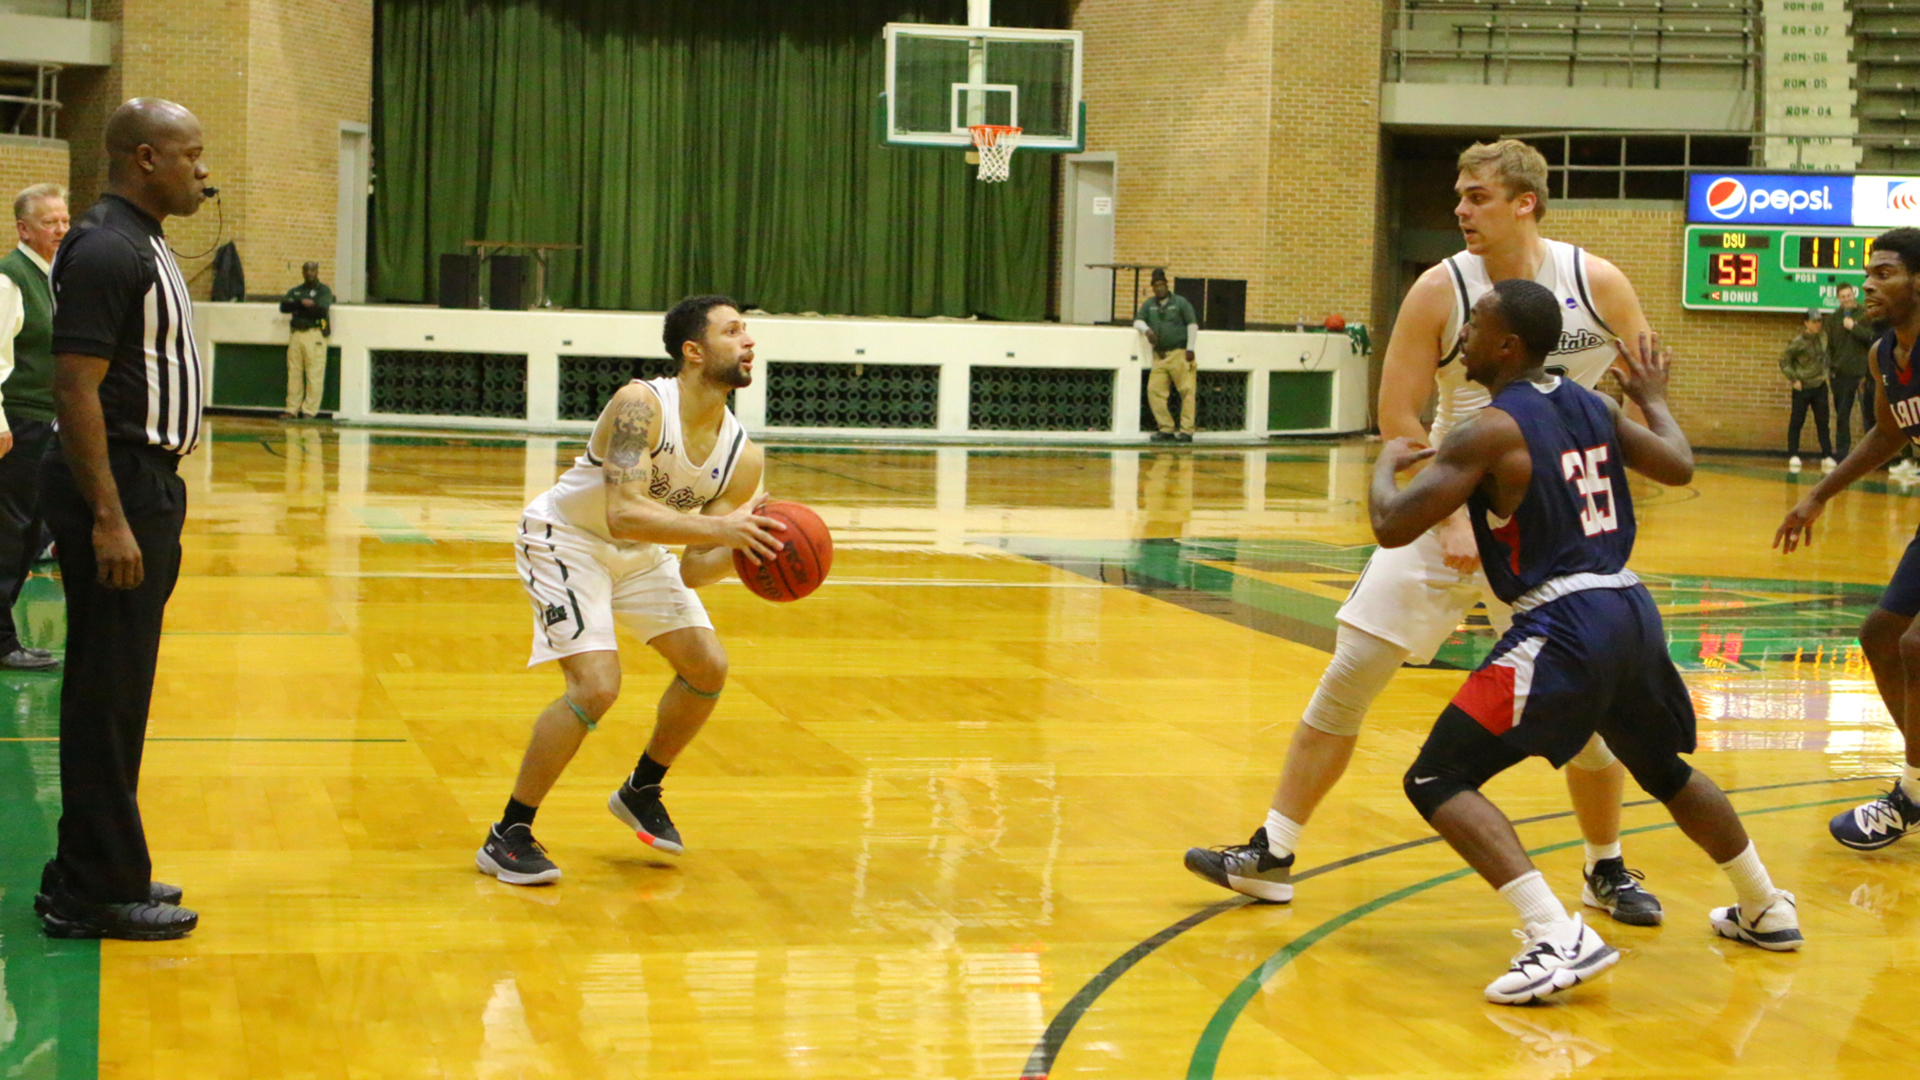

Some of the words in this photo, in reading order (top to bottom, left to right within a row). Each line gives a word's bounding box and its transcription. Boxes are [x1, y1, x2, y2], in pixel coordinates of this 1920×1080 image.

[1750, 186, 1830, 214] pepsi
[1723, 233, 1746, 248] DSU
[1718, 253, 1757, 285] 53
[1795, 274, 1817, 282] POSS
[1722, 291, 1759, 303] BONUS
[1559, 330, 1602, 352] tate
[1562, 443, 1618, 537] 35
